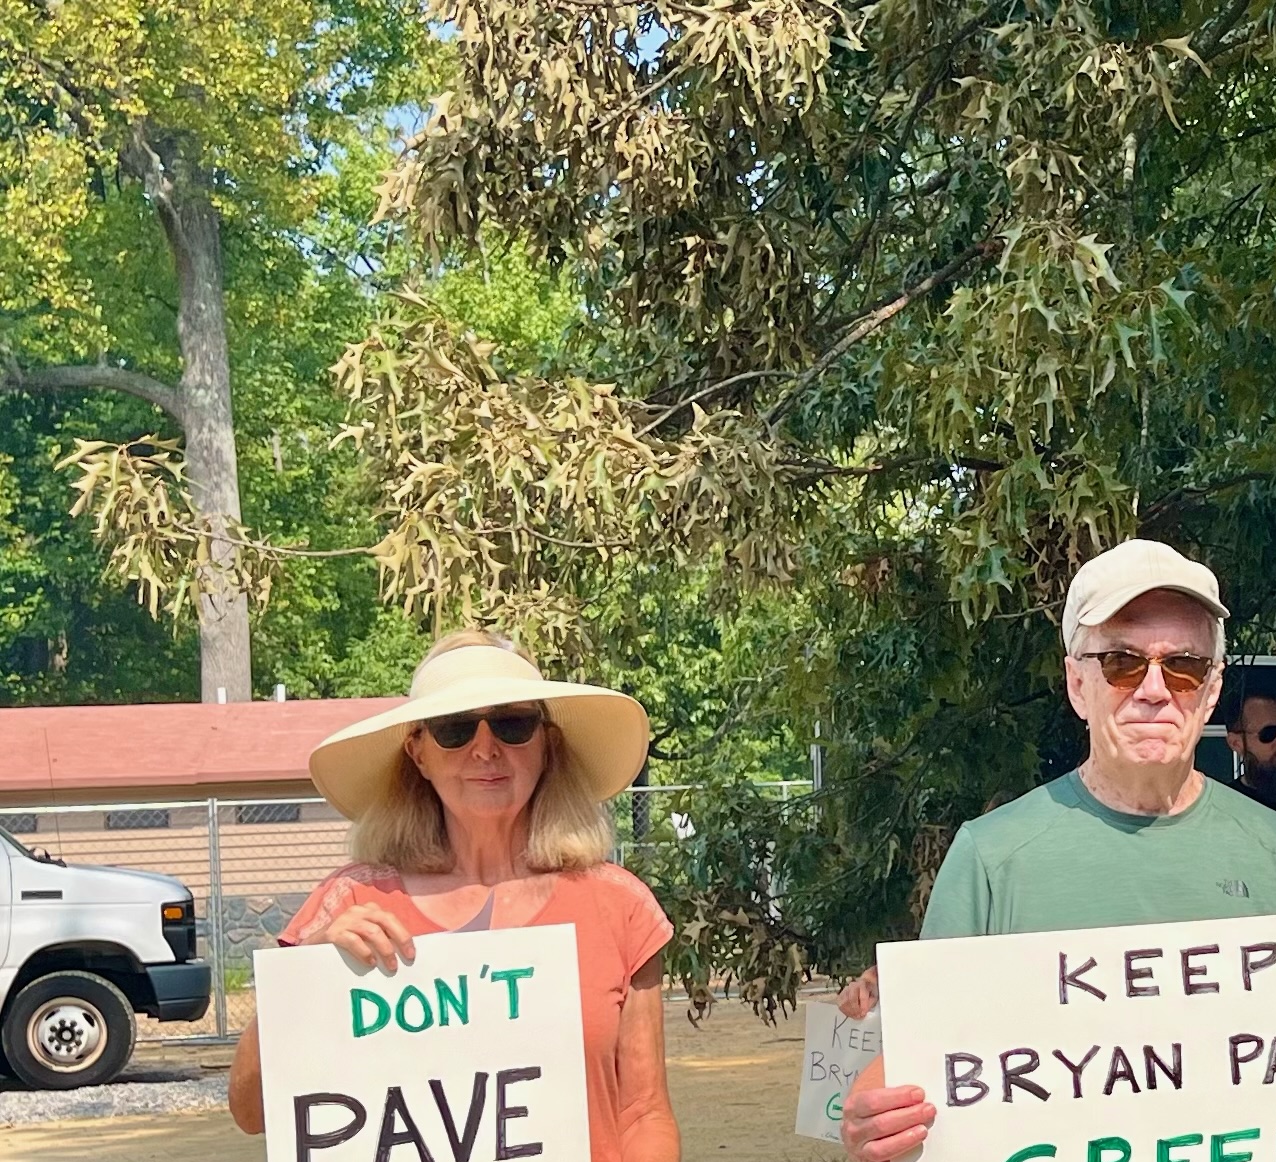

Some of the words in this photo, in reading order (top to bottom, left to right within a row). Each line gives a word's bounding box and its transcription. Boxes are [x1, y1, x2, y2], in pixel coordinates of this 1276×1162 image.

[350, 964, 534, 1038] DON'T
[831, 1014, 882, 1052] KEE
[945, 1043, 1182, 1107] BRYAN
